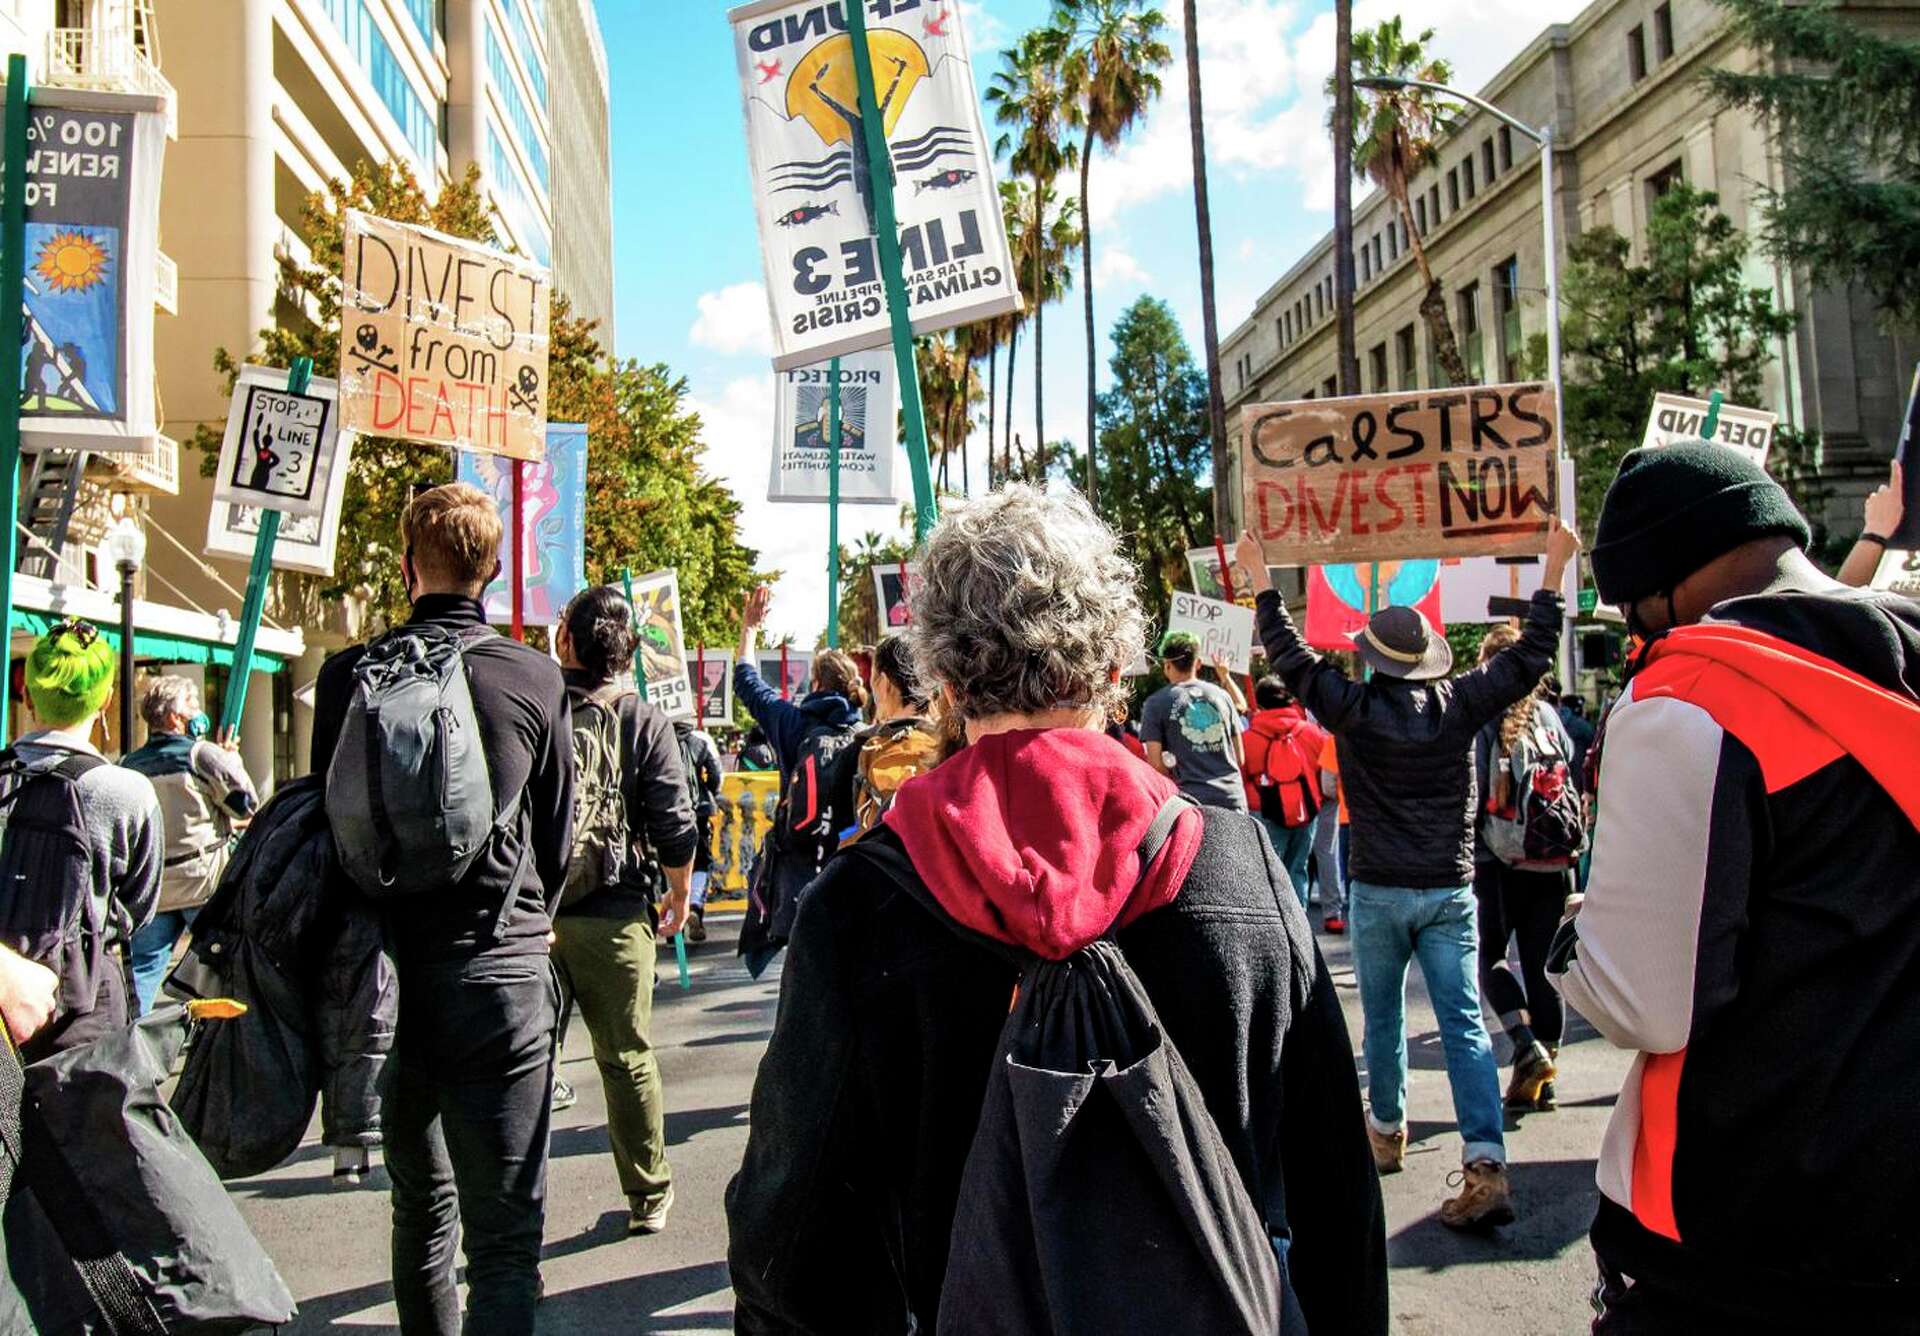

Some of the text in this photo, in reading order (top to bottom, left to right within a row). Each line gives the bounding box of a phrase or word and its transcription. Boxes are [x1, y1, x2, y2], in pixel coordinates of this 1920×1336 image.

[356, 233, 542, 352] DIVEST
[411, 327, 497, 385] from
[256, 394, 299, 417] STOP
[373, 371, 509, 447] DEATH
[278, 426, 311, 447] LINE
[286, 451, 303, 474] 3
[1255, 450, 1556, 541] DIVEST NOW
[1176, 595, 1223, 621] STOP
